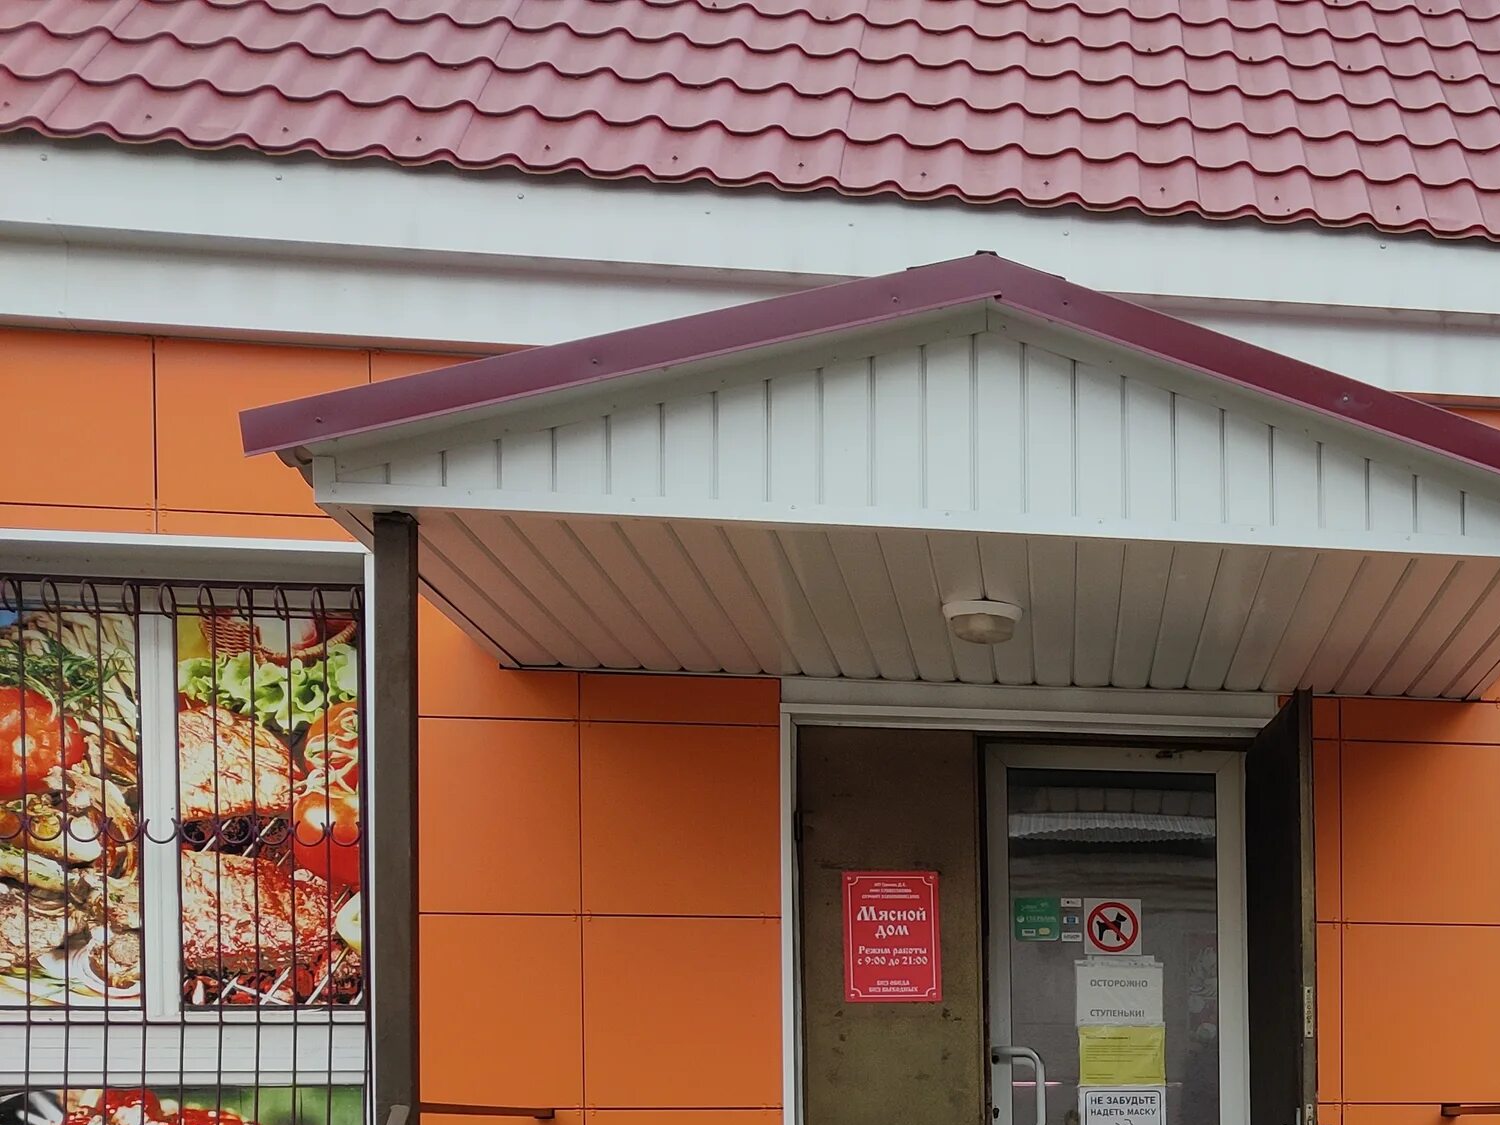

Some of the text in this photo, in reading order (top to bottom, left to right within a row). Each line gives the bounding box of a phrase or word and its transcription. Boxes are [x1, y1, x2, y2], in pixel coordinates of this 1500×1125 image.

[857, 905, 927, 922] Мясной
[875, 924, 909, 939] дом
[858, 945, 927, 956] Режим работы
[864, 956, 887, 965] 9:00
[888, 958, 900, 967] до
[902, 956, 929, 965] 21:00
[1090, 979, 1148, 988] ОСТОРОЖНО
[1090, 1009, 1145, 1018] СТУПЕНЬКИ!
[1090, 1096, 1156, 1106] НЕ ЗАБУДЬТЕ
[1090, 1108, 1157, 1117] НАДЕТЬ МАСКУ
